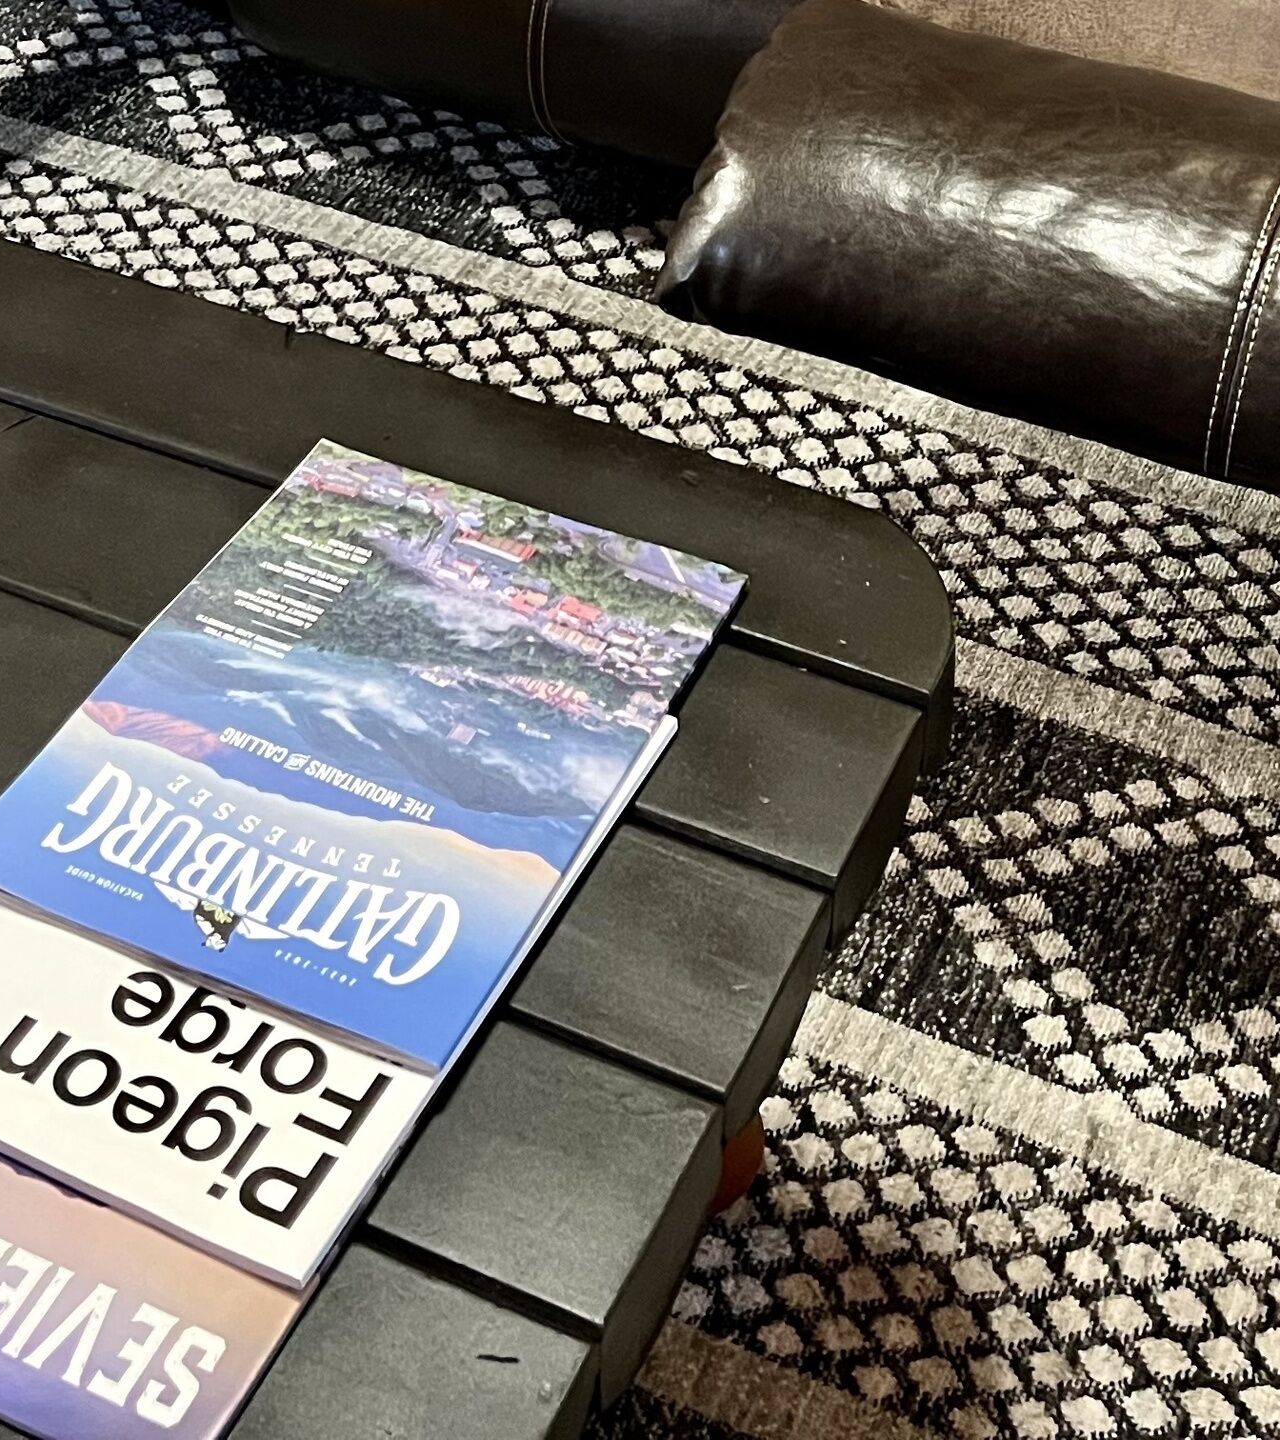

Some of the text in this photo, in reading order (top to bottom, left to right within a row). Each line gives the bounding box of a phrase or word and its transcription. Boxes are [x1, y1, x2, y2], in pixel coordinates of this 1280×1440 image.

[220, 727, 288, 762] CALLING
[305, 760, 401, 808] MOUNTAINS
[167, 774, 401, 877] TENNESSEE
[399, 797, 435, 821] THE
[42, 762, 460, 985] GATLINBURG
[64, 865, 144, 901] VACATION GUIDE
[111, 971, 394, 1146] Forge
